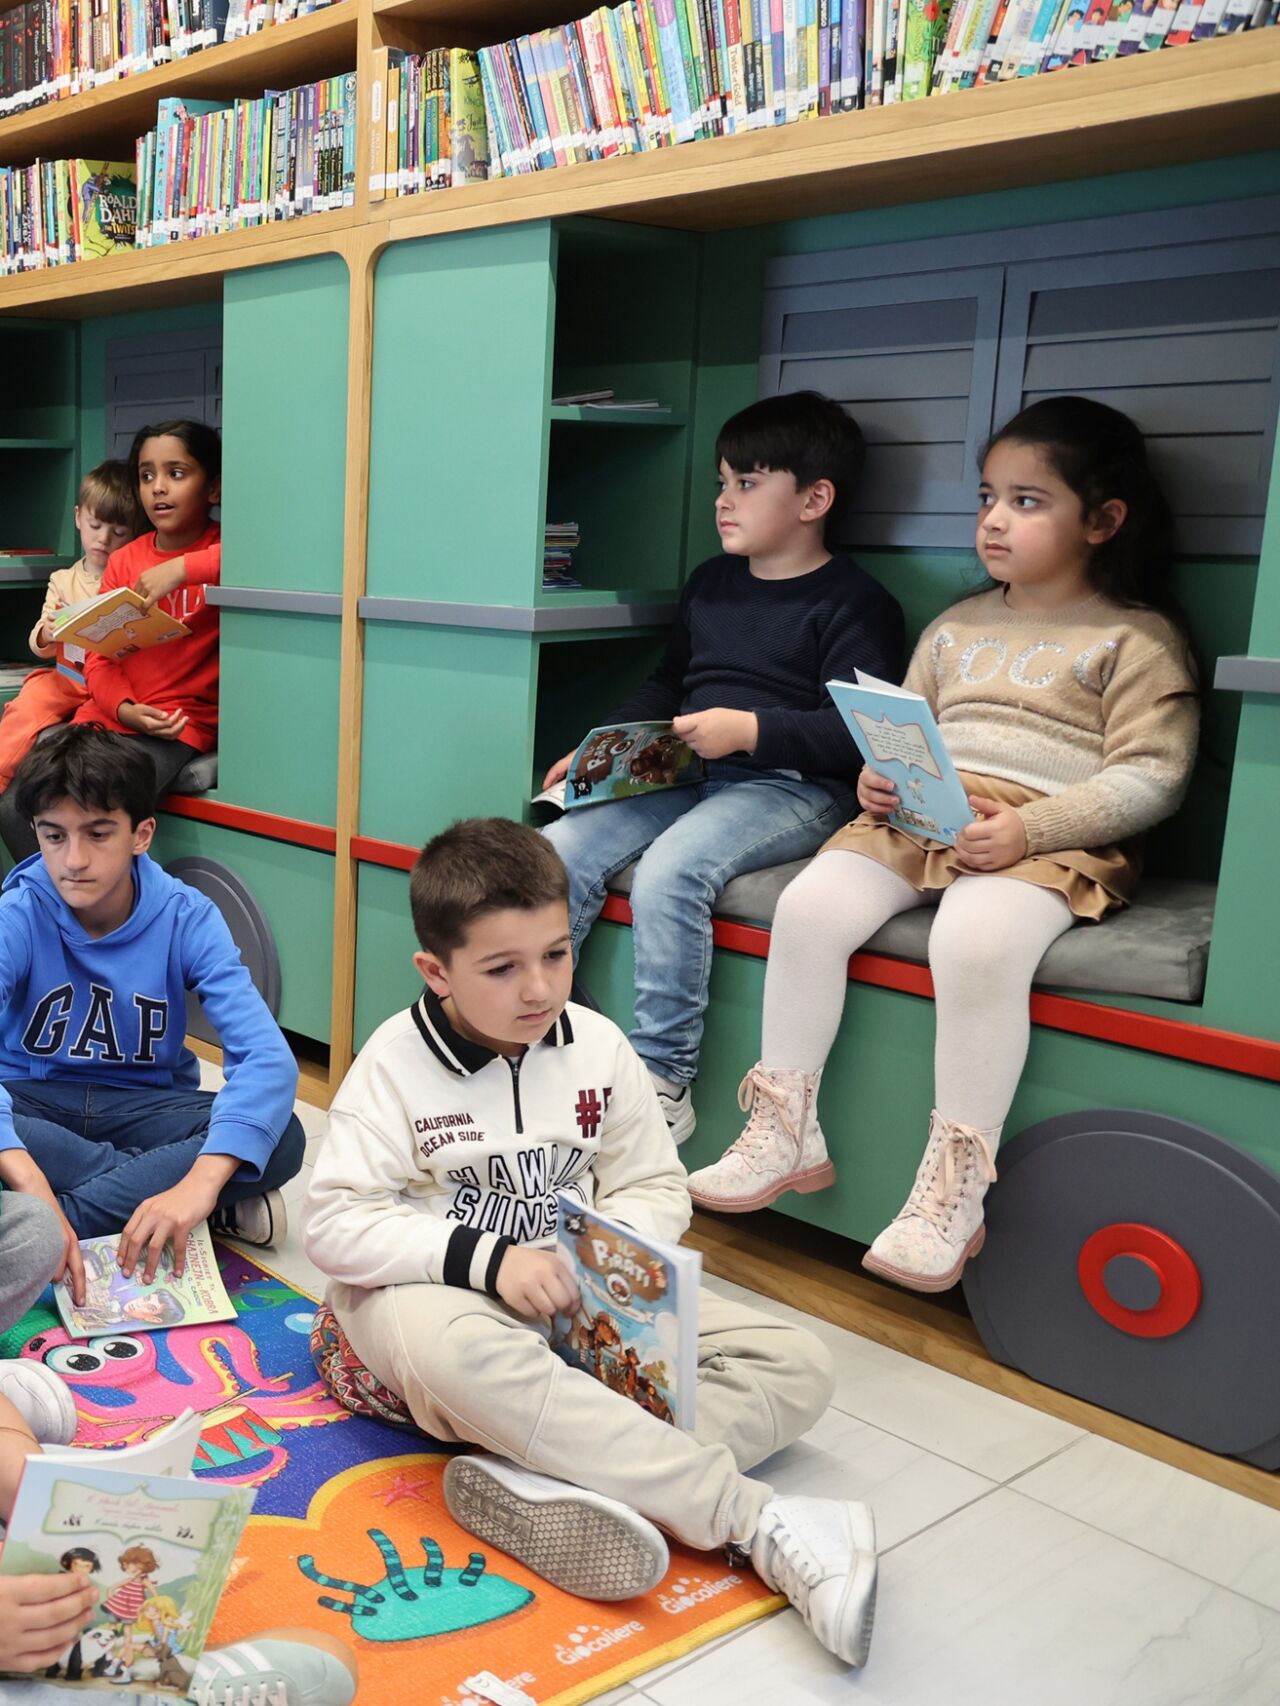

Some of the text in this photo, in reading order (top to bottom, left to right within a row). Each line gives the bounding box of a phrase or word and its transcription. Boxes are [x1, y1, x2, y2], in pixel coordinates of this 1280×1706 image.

[733, 83, 742, 106] Gold
[99, 194, 137, 209] ROALD
[100, 208, 137, 225] DAHL
[111, 222, 136, 235] TWITS
[21, 982, 169, 1063] GAP
[414, 1112, 475, 1134] CALIFORNIA
[419, 1131, 486, 1158] OCEAN SIDE
